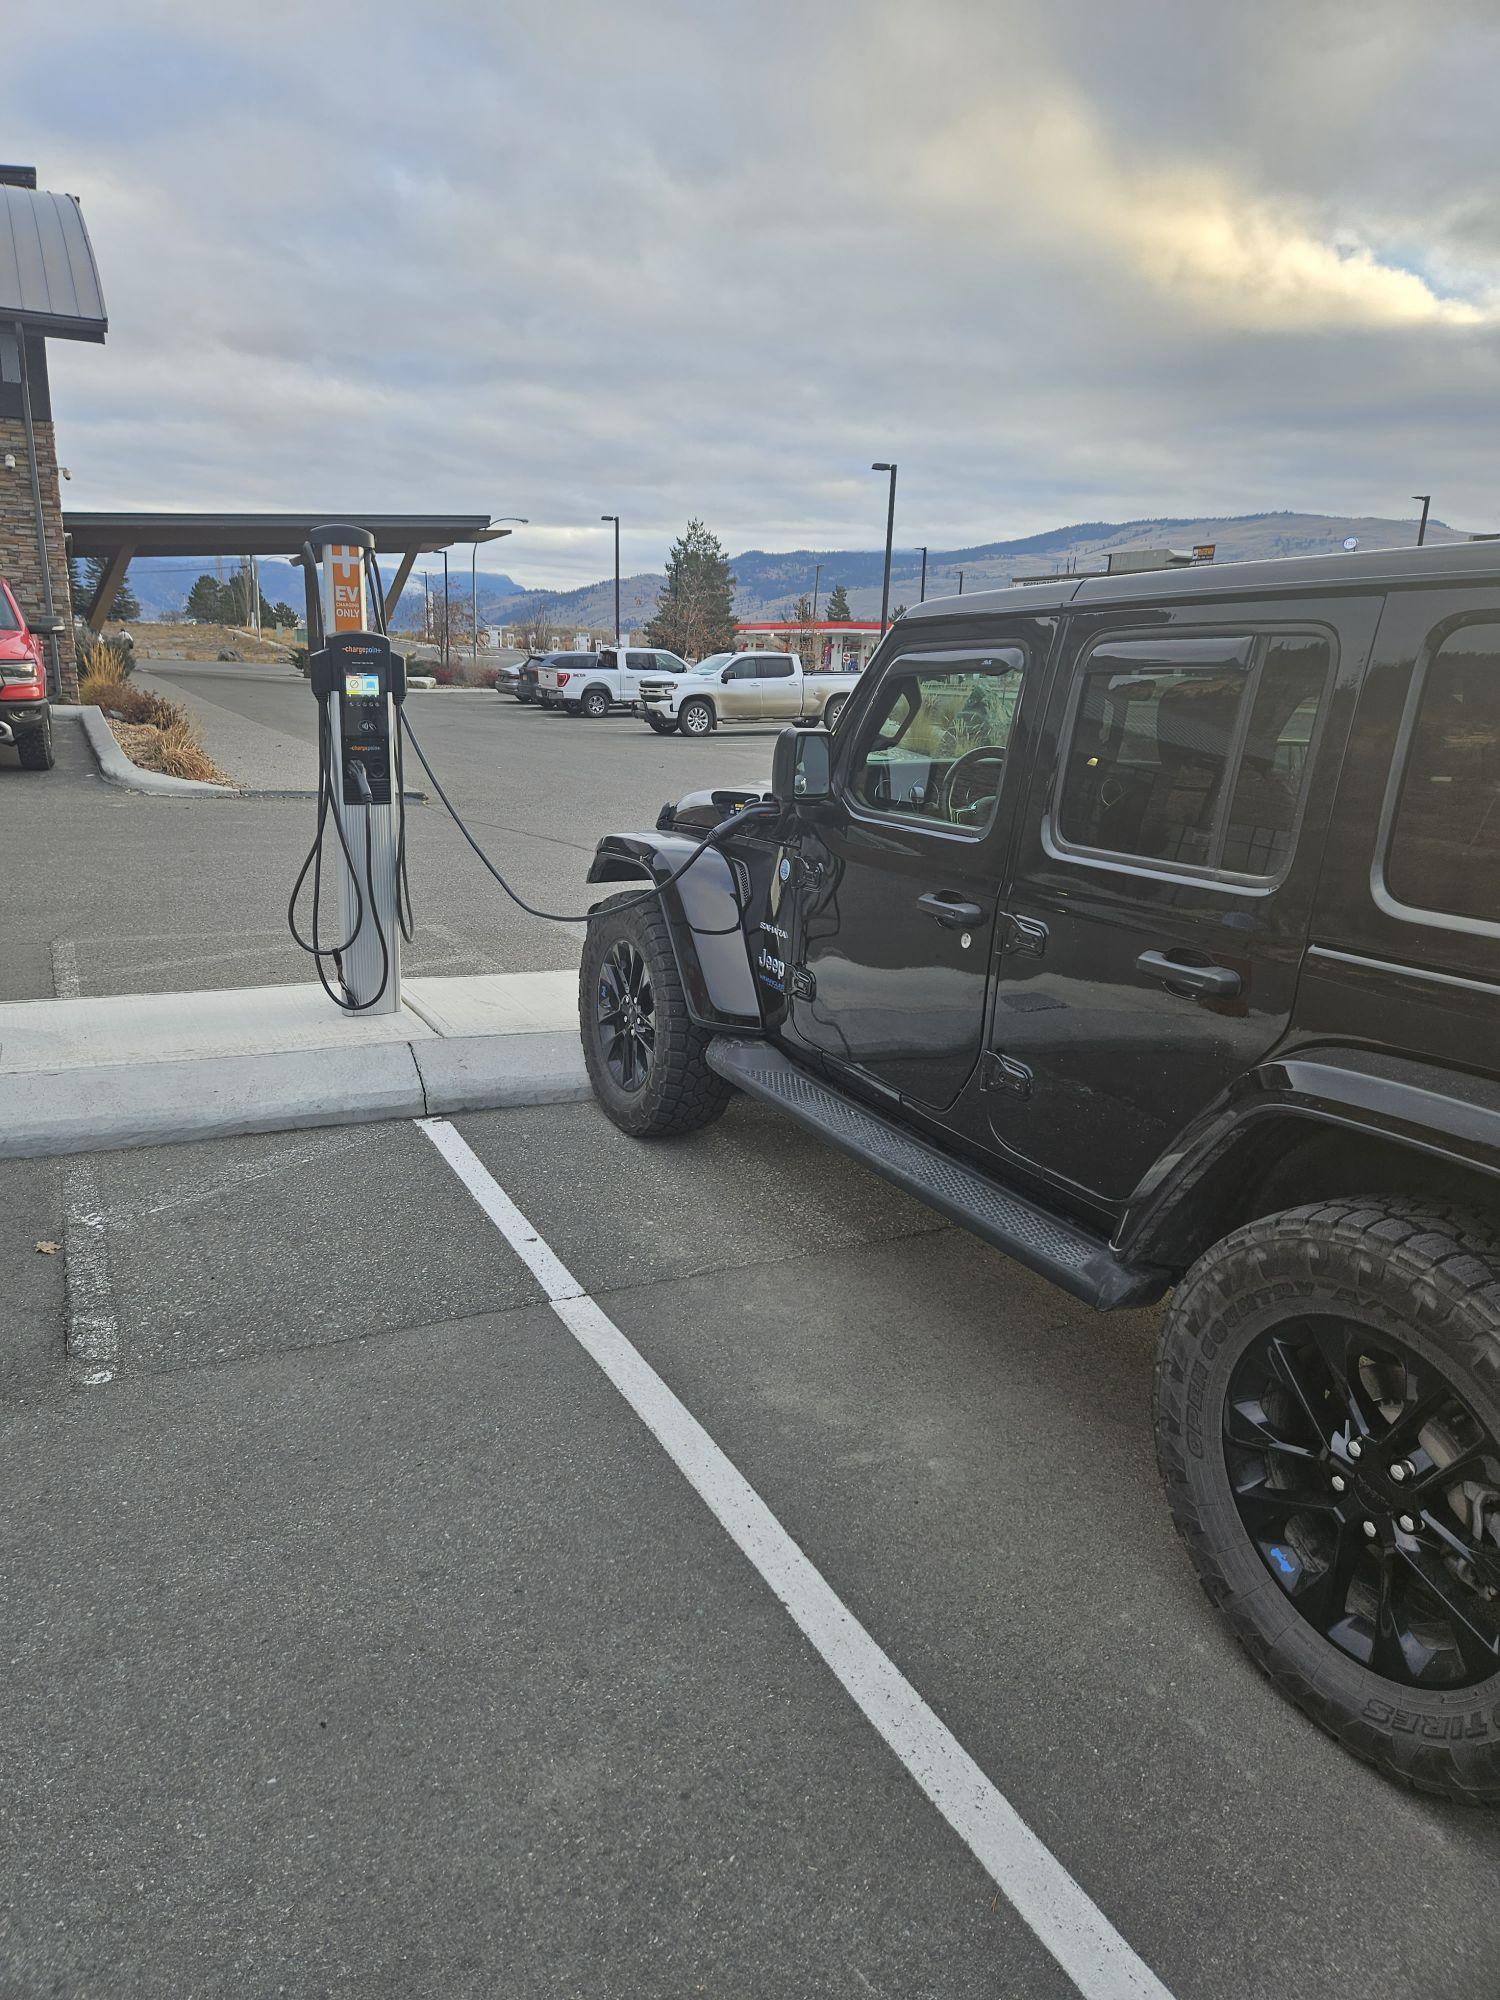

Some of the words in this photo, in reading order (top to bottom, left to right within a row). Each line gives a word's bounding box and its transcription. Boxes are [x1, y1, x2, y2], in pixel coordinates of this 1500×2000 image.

[335, 585, 359, 602] EV
[336, 608, 360, 618] ONLY
[758, 948, 785, 979] Jeep
[1186, 1360, 1210, 1459] OPEN
[1201, 1282, 1316, 1360] COUNTRY
[1362, 1698, 1489, 1740] TIRES
